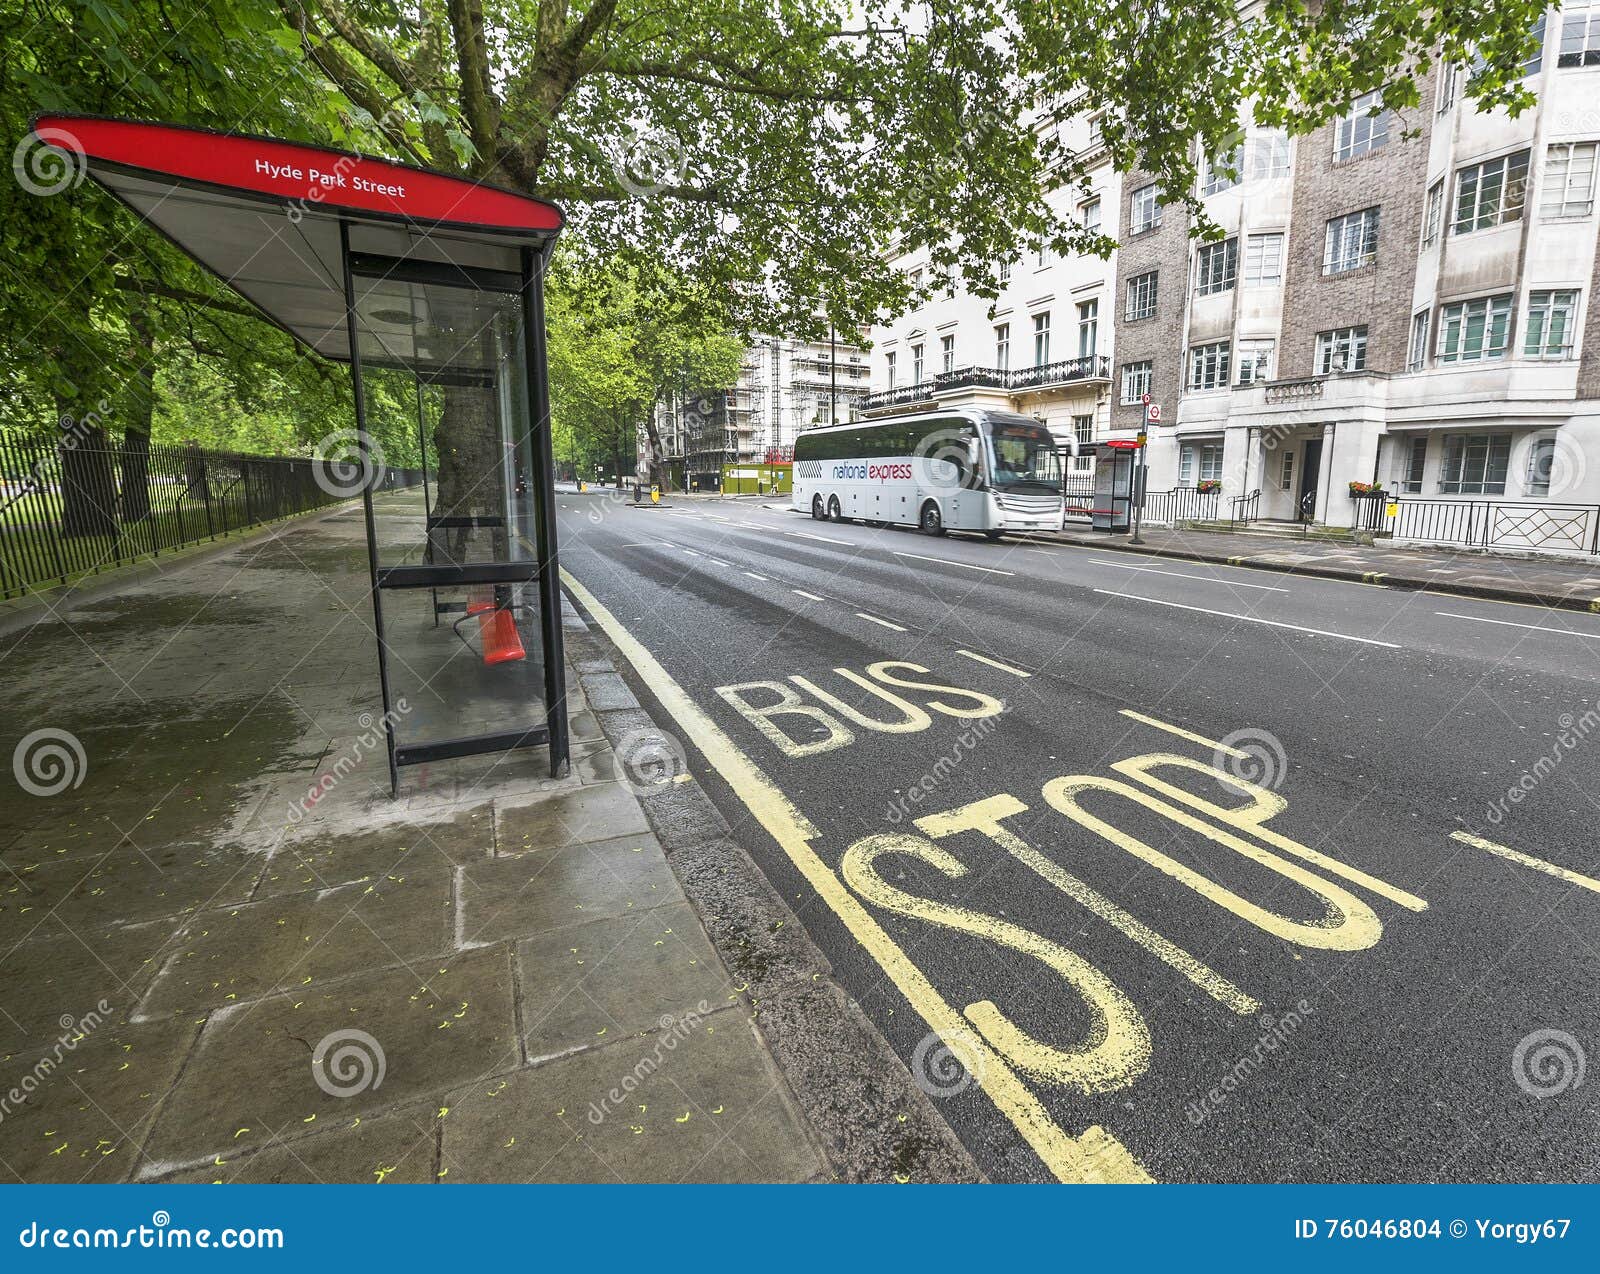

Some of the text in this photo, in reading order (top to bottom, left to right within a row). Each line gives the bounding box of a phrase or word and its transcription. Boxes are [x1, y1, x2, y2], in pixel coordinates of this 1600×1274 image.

[255, 159, 406, 198] Hyde Park Street
[832, 460, 912, 485] national express
[713, 660, 1004, 758] BUS
[840, 752, 1429, 1094] STOP
